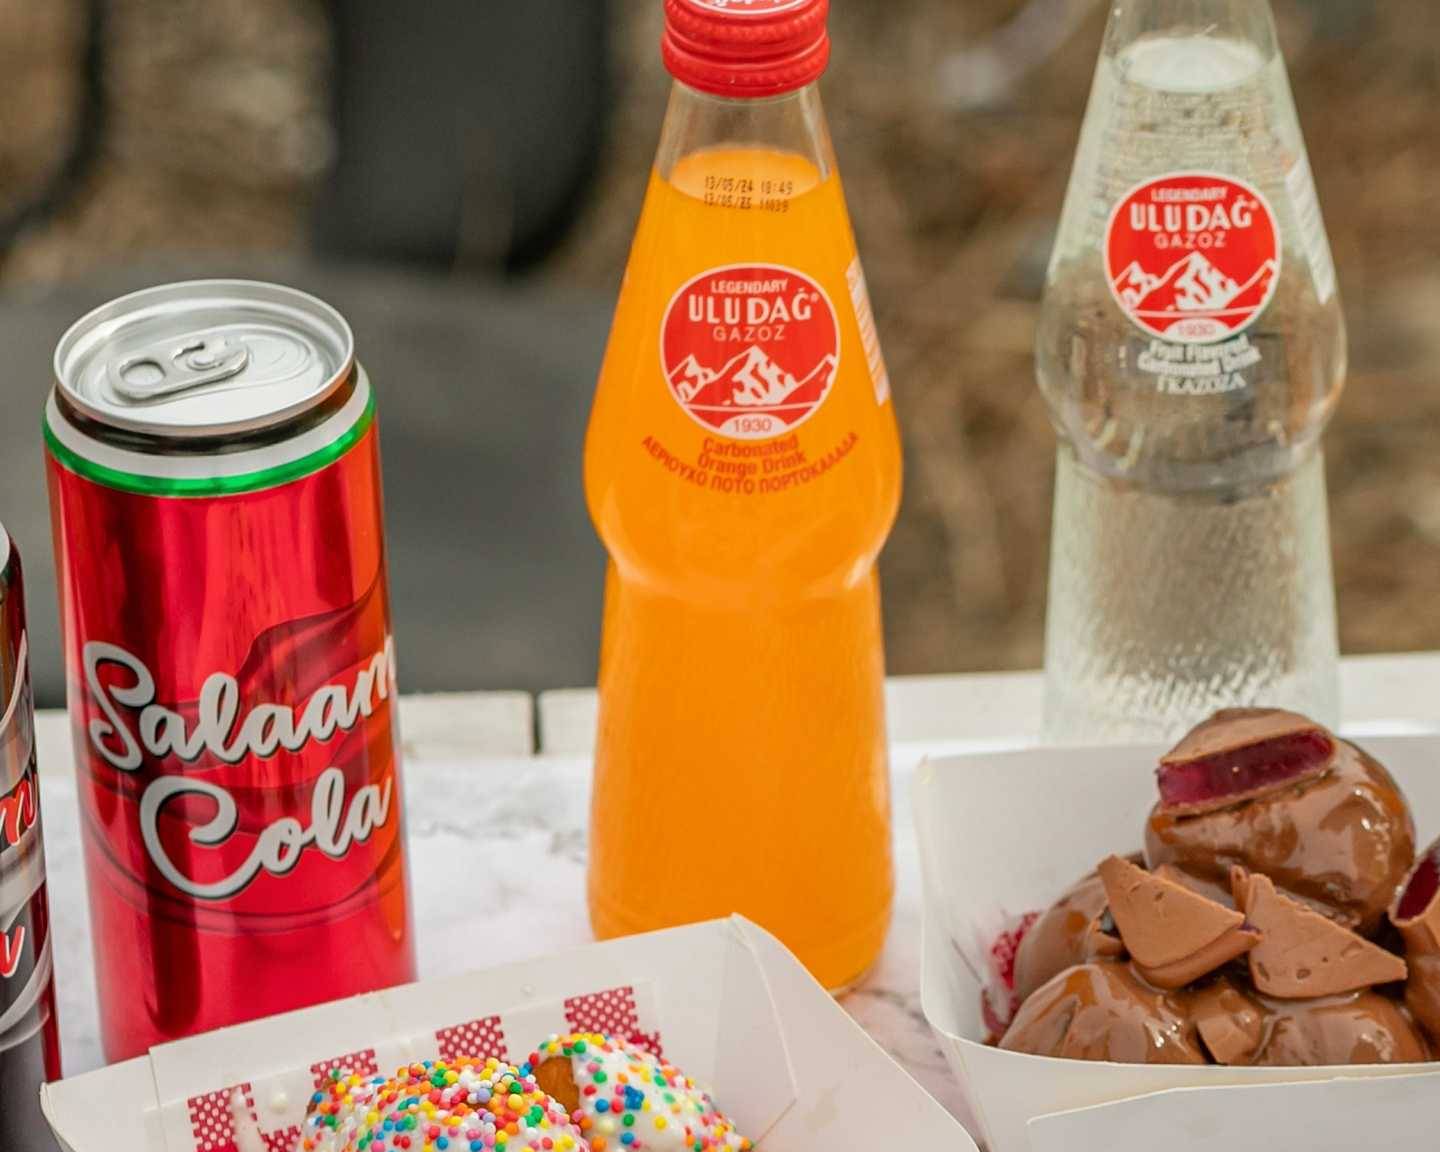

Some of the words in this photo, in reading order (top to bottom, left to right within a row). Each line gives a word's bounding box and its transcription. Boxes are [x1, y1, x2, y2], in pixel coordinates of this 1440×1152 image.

[1130, 194, 1252, 232] ULUDAĞ
[1153, 230, 1227, 249] GAZOZ
[711, 279, 788, 294] LEGENDARY
[688, 288, 812, 325] ULUDAĞ
[713, 325, 785, 342] GAZOZ
[733, 418, 772, 433] 1930
[703, 434, 799, 458] Carbonated
[697, 453, 757, 477] Orange
[762, 451, 807, 474] Drink
[139, 767, 392, 898] Cola
